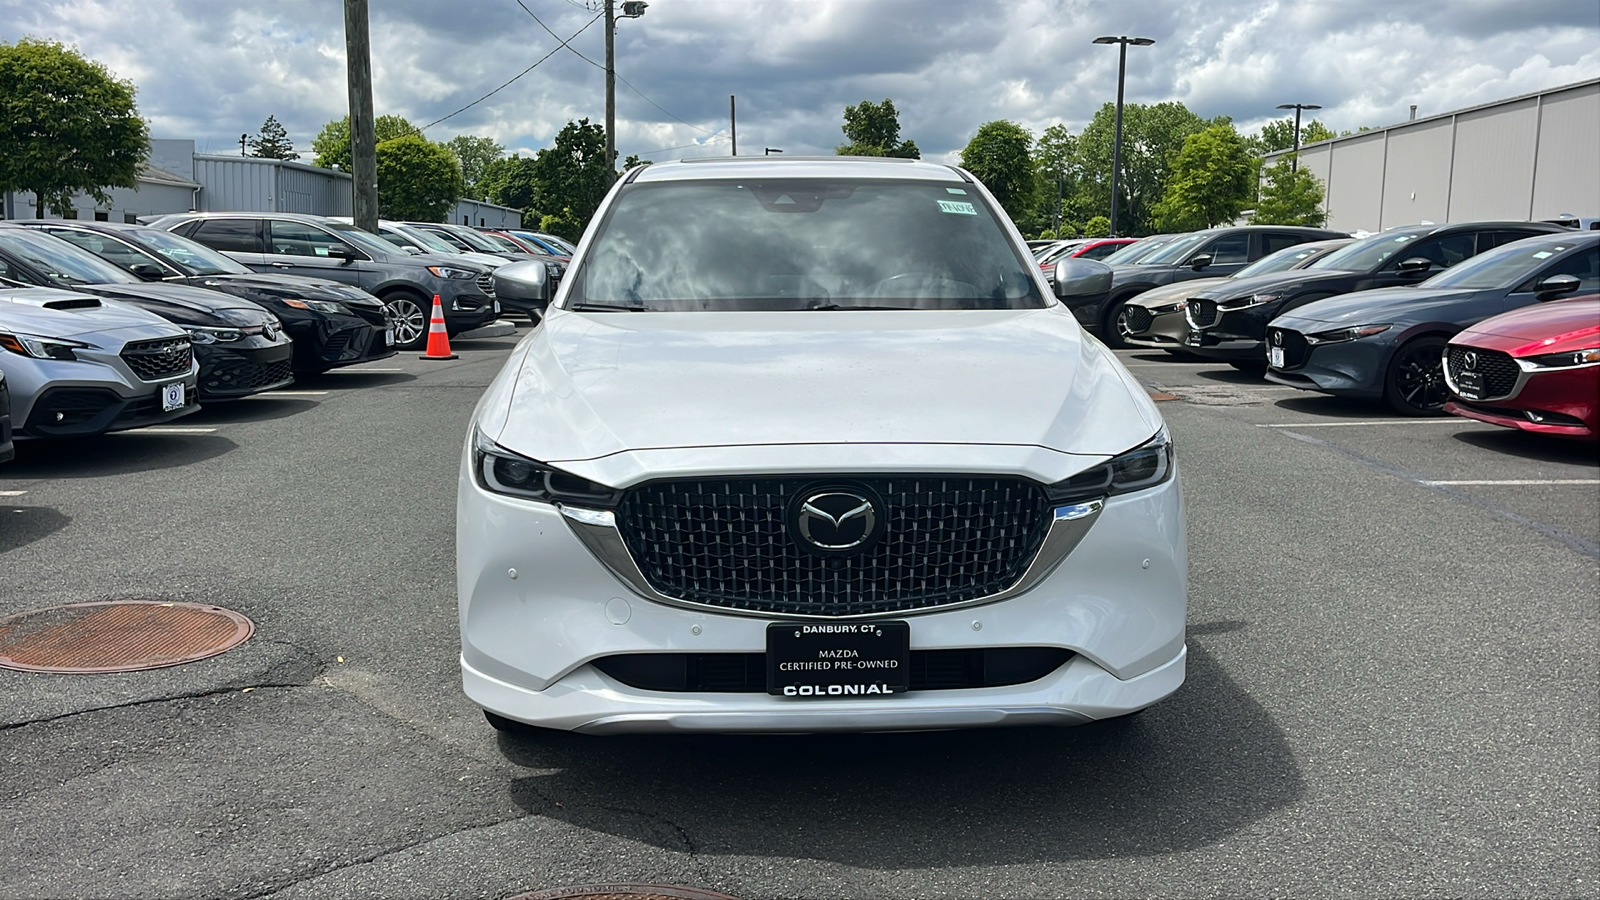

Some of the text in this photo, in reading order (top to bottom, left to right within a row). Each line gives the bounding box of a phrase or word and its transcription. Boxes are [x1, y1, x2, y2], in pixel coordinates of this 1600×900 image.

[803, 625, 876, 633] DANBURY, CT
[819, 650, 859, 658] MAZDA
[779, 660, 898, 671] CERTIFIED PRE-OWNED
[783, 684, 894, 696] COLONIAL
